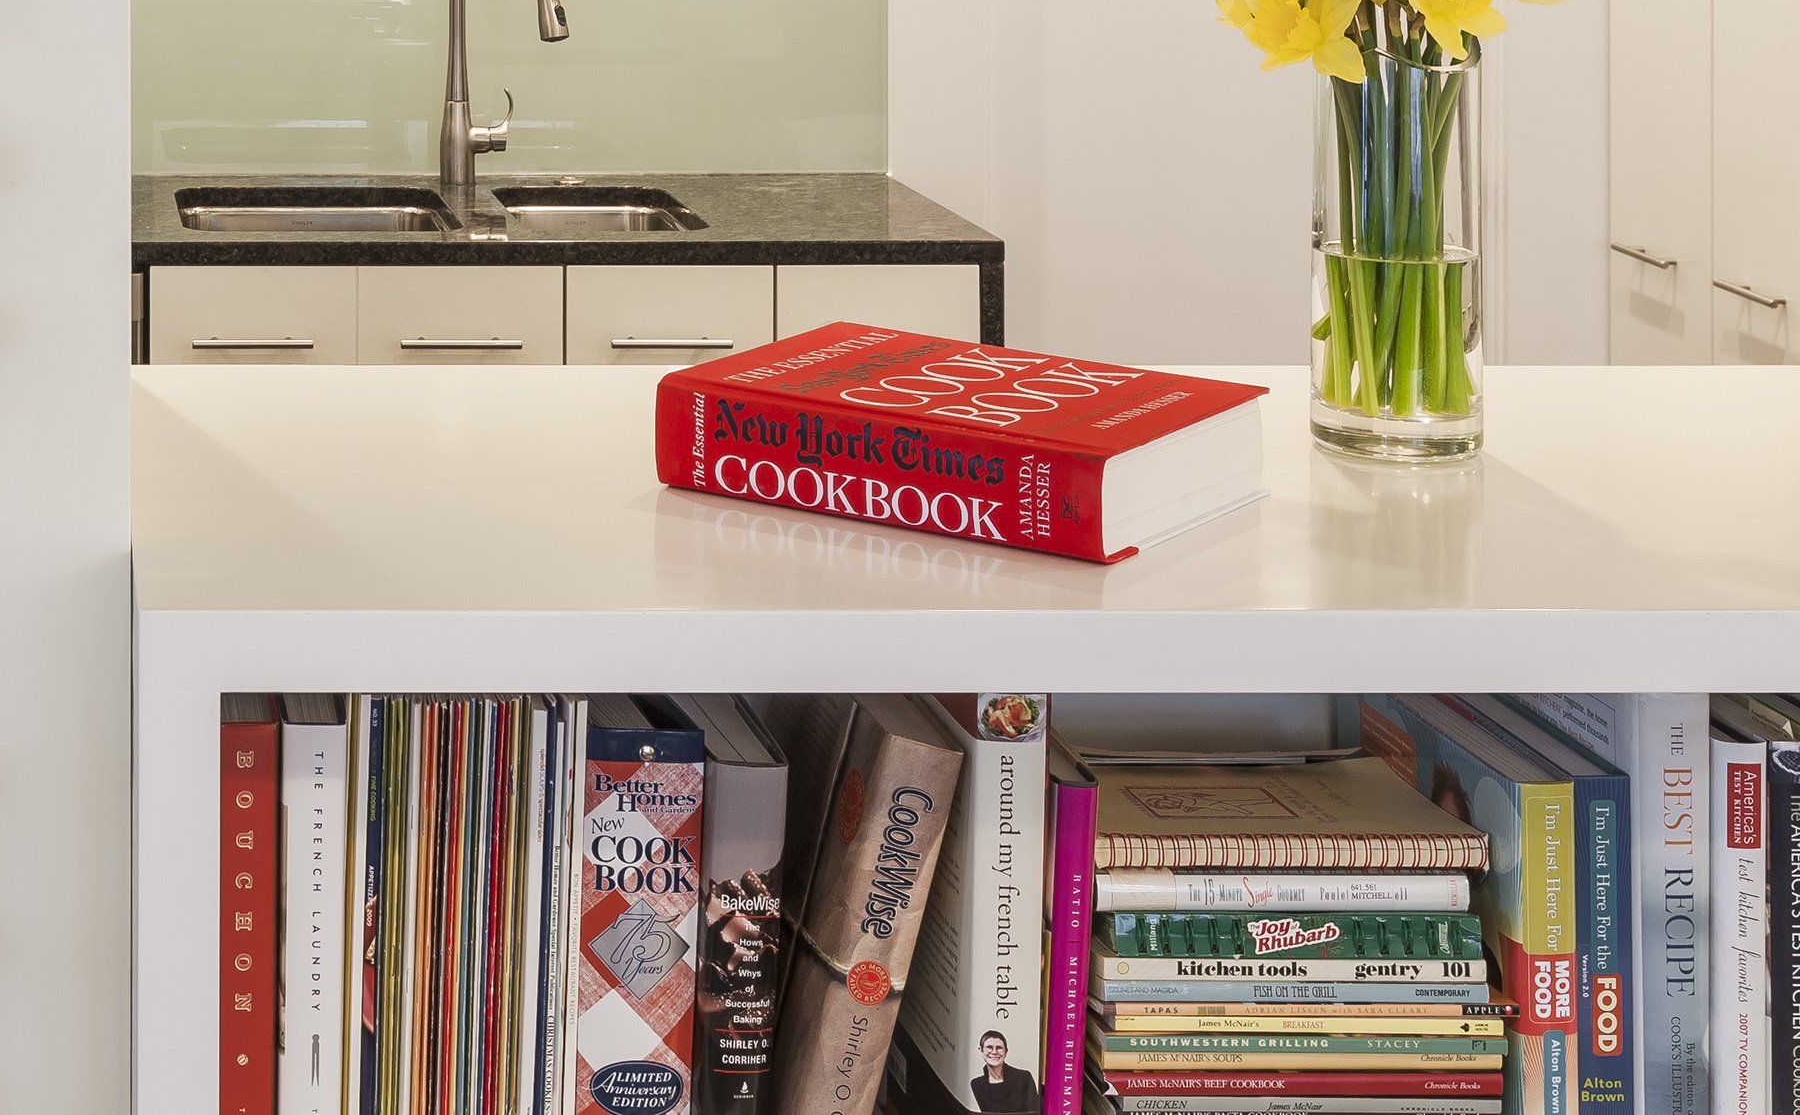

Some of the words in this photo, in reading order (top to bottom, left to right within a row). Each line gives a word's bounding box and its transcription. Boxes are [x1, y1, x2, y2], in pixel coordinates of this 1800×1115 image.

[723, 362, 786, 383] THE
[783, 331, 899, 372] ESSENTIAL
[839, 347, 1051, 407] COOK
[924, 362, 1146, 427] BOOK
[692, 392, 706, 459] Essential
[714, 398, 790, 449] New
[795, 411, 886, 469] York
[891, 426, 1006, 486] Times
[692, 465, 706, 487] The
[714, 454, 1007, 541] COOKBOOK
[1019, 454, 1035, 540] AMANDA
[1036, 462, 1051, 538] HESSER
[1670, 722, 1684, 756] THE
[314, 751, 324, 789] THE
[594, 773, 664, 794] Better
[1733, 770, 1742, 795] TEST
[616, 793, 697, 812] Homes
[661, 806, 697, 814] Gardens
[999, 755, 1021, 836] around
[1663, 766, 1693, 855] BEST
[1743, 770, 1758, 845] America's
[591, 817, 625, 834] New
[1545, 803, 1561, 831] I'm
[1595, 806, 1610, 831] I'm
[1733, 799, 1742, 845] KITCHEN
[312, 808, 323, 892] FRENCH
[591, 835, 696, 865] COOK
[861, 786, 935, 939] CookWise
[991, 843, 1014, 878] my
[1545, 835, 1561, 872] Just
[1595, 835, 1610, 869] Just
[235, 750, 254, 1012] BOUCHON
[593, 863, 696, 894] BOOK
[1738, 857, 1754, 883] test
[721, 894, 780, 911] BakeWise
[1071, 874, 1081, 928] RATIO
[1242, 876, 1275, 908] Single
[1351, 892, 1393, 900] MITCHELL
[1546, 877, 1562, 920] Here
[1596, 873, 1611, 911] Here
[997, 883, 1020, 958] french
[1257, 920, 1292, 938] Joy
[1596, 915, 1611, 941] For
[1738, 890, 1760, 938] kitchen
[610, 913, 680, 964] 75
[740, 938, 763, 946] Hows
[1257, 925, 1338, 953] Rhubarb
[1546, 923, 1562, 952] For
[1664, 866, 1696, 998] RECIPE
[311, 911, 321, 1011] LAUNDRY
[618, 957, 663, 987] Years
[742, 954, 759, 962] and
[854, 963, 867, 974] NO
[869, 963, 887, 981] MORE
[1177, 960, 1253, 977] kitchen
[1258, 961, 1308, 977] tools
[1355, 962, 1423, 980] gentry
[1442, 962, 1472, 977] 101
[1597, 945, 1612, 970] the
[738, 969, 762, 979] Whys
[745, 984, 754, 993] of
[1555, 960, 1570, 1018] MORE
[1731, 945, 1762, 1003] favorites
[725, 999, 770, 1008] Successful
[864, 981, 888, 1002] RECIPES
[996, 964, 1019, 1020] table
[1066, 956, 1078, 1030] MICHAEL
[1253, 985, 1273, 998] FISH
[1275, 985, 1289, 998] ON
[1291, 986, 1309, 998] THE
[1312, 986, 1338, 999] GRILL
[1415, 989, 1471, 997] CONTEMPORARY
[1534, 960, 1552, 1019] FOOD
[733, 1015, 762, 1024] Baking
[1198, 1019, 1222, 1029] James
[1224, 1019, 1260, 1028] McNair's
[1282, 1021, 1324, 1029] BREAKFAST
[1466, 1006, 1501, 1015] APPLE
[1596, 977, 1618, 1053] FOOD
[1738, 1013, 1748, 1035] 2007
[546, 1015, 555, 1067] CHRISTMAS
[719, 1038, 759, 1049] SHIRLEY
[836, 1015, 869, 1079] Shirley
[1130, 1038, 1250, 1047] SOUTHWESTERN
[1258, 1039, 1329, 1047] GRILLING
[1367, 1040, 1420, 1048] STACEY
[1670, 1016, 1682, 1061] COOK'S
[1739, 1037, 1748, 1052] TV
[721, 1054, 767, 1064] CORRIHER
[1137, 1054, 1167, 1064] JAMES
[1213, 1054, 1243, 1063] SOUPS
[1420, 1054, 1454, 1062] Chronicle
[1456, 1054, 1477, 1062] Books
[1551, 1039, 1561, 1072] Alton
[545, 1070, 553, 1111] COOKIES
[593, 1072, 677, 1100] Anniversary
[616, 1072, 673, 1083] LIMITED
[1063, 1041, 1075, 1115] RUHLMAN
[1126, 1079, 1157, 1089] JAMES
[1204, 1079, 1228, 1088] BEEF
[1230, 1079, 1286, 1089] COOKBOOK
[1583, 1077, 1622, 1089] Alton
[612, 1096, 667, 1108] EDITION
[833, 1084, 851, 1103] O.
[1136, 1100, 1188, 1110] CHICKEN
[1267, 1102, 1291, 1112] James
[1293, 1102, 1323, 1110] McNair
[1551, 1076, 1562, 1114] Brown
[1581, 1091, 1625, 1102] Brown
